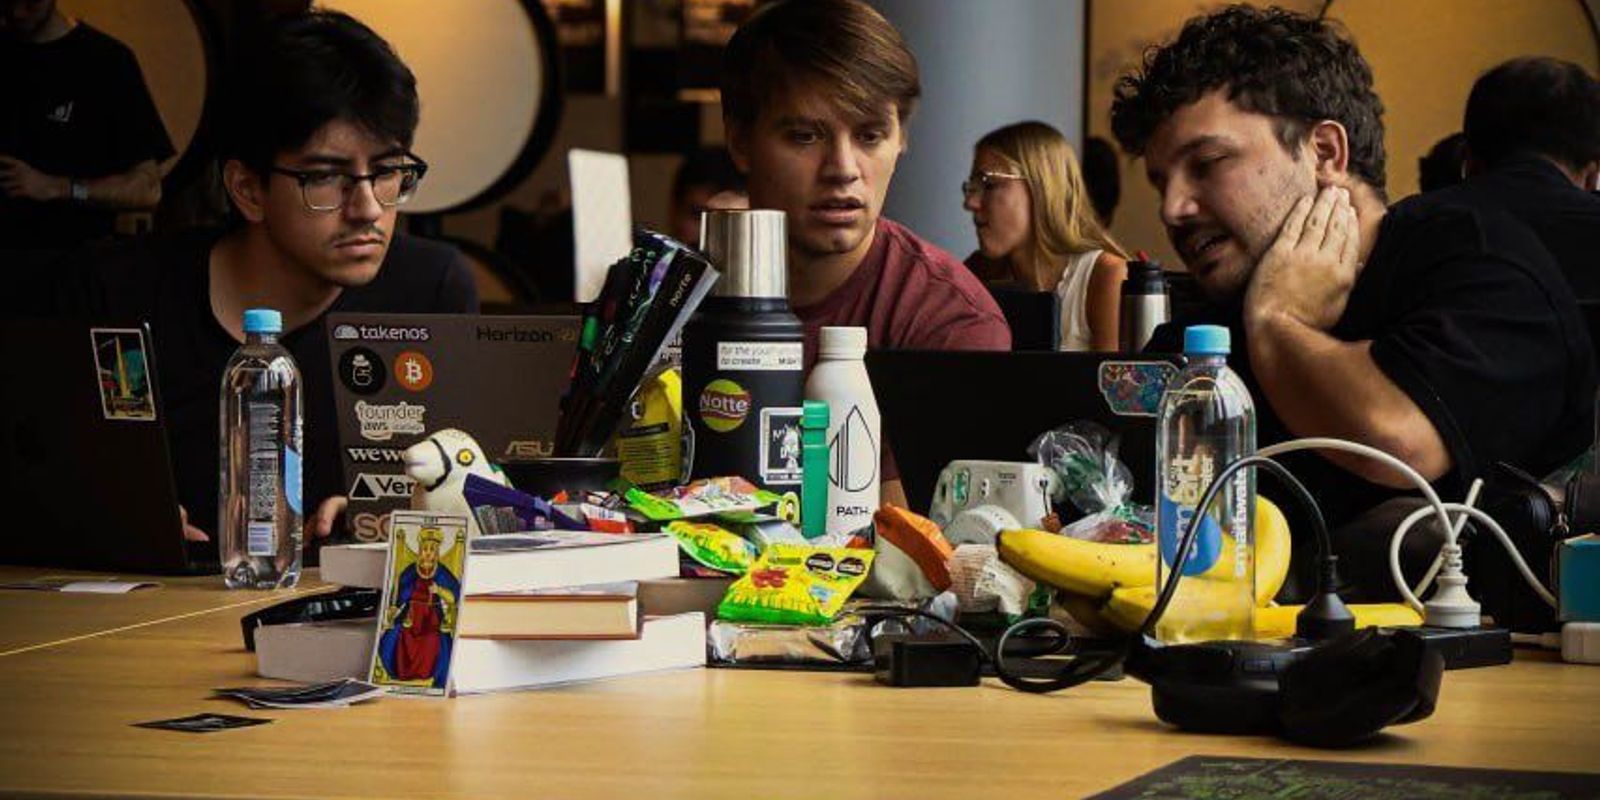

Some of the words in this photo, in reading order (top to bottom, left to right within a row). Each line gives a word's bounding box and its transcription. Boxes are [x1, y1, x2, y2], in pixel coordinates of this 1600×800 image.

[361, 324, 429, 341] takenos
[476, 324, 553, 341] Horizon
[700, 393, 748, 412] Notte
[358, 403, 423, 420] founder
[347, 447, 406, 461] wew
[505, 440, 555, 457] ASU
[376, 476, 416, 495] Ver
[1233, 454, 1248, 578] smartwate
